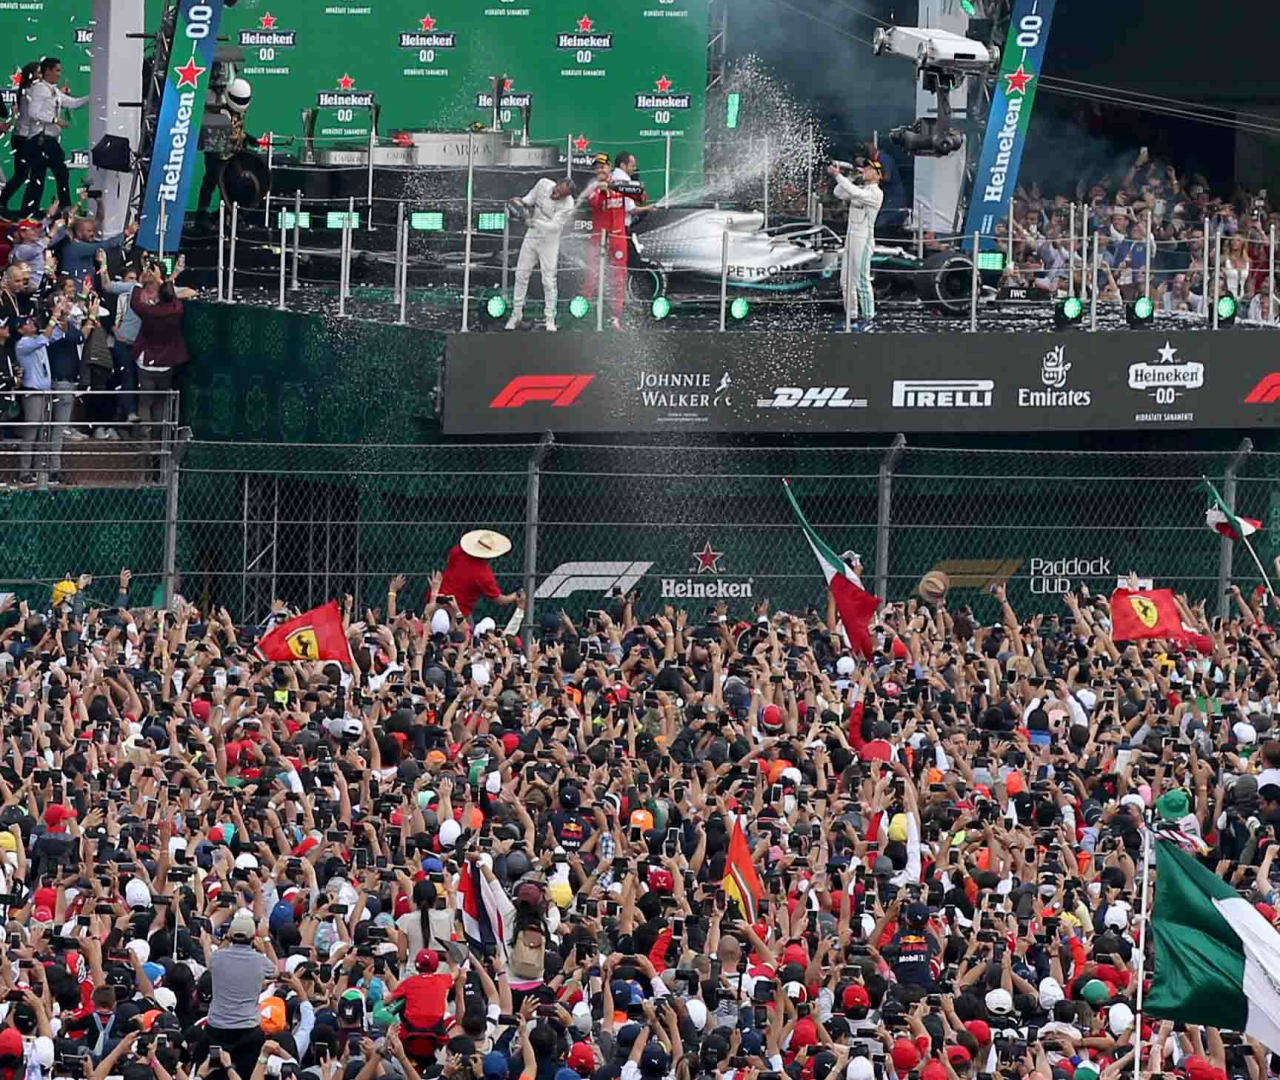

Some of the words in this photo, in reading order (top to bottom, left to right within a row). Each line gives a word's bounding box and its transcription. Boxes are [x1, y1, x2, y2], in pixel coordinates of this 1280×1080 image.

[242, 33, 293, 45] Heineken
[401, 34, 452, 46] Heineken
[559, 35, 610, 47] Heineken
[320, 94, 371, 106] Heineken
[478, 95, 529, 107] Heeken
[637, 96, 688, 108] Heineken
[159, 92, 195, 202] Heineken
[984, 97, 1022, 202] Heineken
[1010, 290, 1027, 298] IWC
[637, 372, 711, 390] JOHNNIE
[1133, 369, 1199, 383] Heineken
[641, 391, 710, 407] WALKER
[772, 387, 853, 407] DHL
[892, 379, 995, 407] PIRELLI
[1018, 388, 1091, 407] Emirates
[1030, 556, 1111, 576] Paddock
[660, 579, 753, 598] Heineken
[1030, 576, 1071, 594] Club
